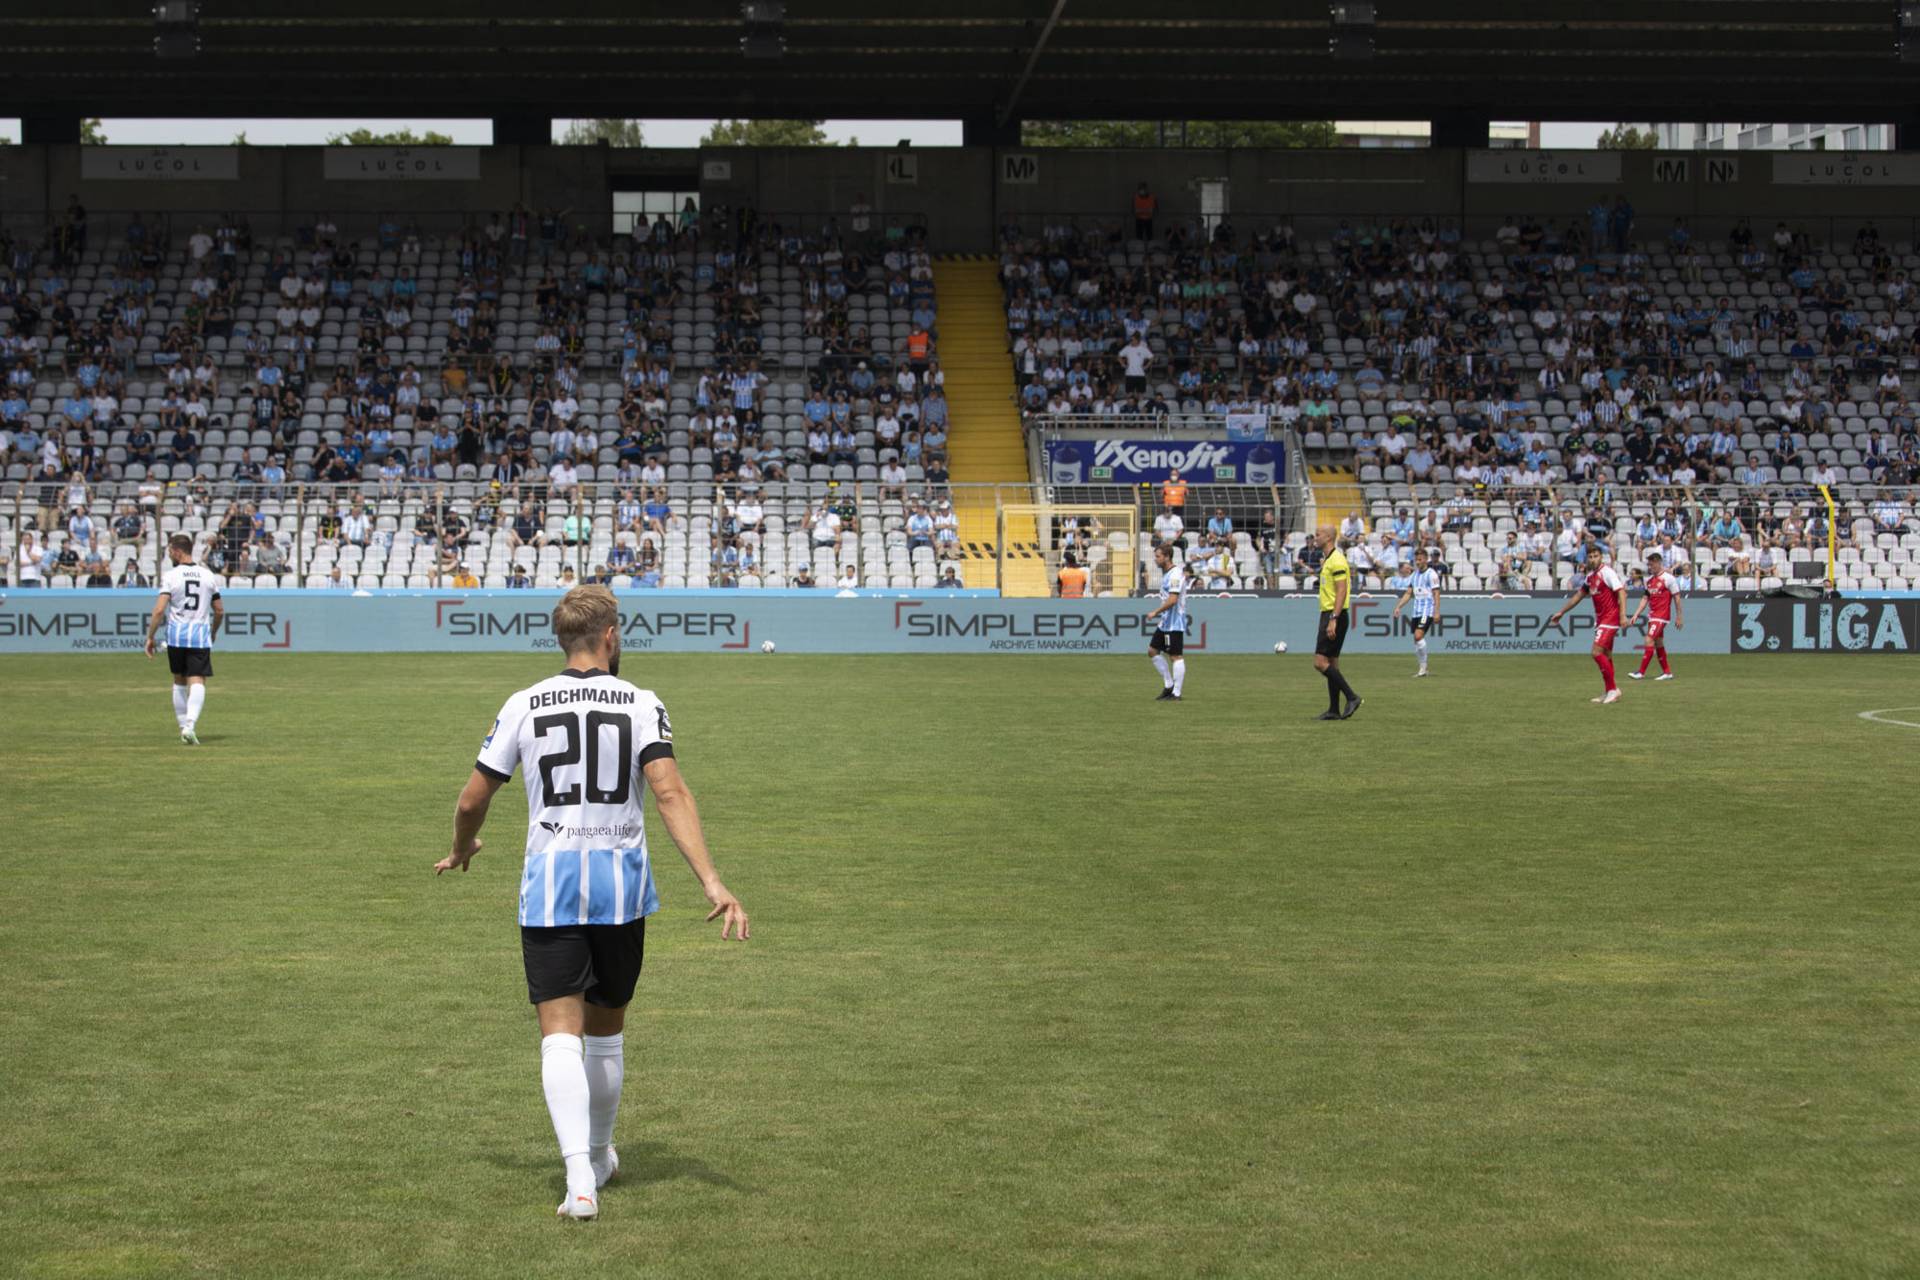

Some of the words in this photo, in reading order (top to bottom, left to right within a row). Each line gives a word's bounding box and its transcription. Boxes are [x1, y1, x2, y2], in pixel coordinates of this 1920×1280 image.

[118, 160, 200, 171] LUCOL
[361, 160, 443, 171] LUCOL
[898, 157, 913, 178] L
[1007, 158, 1027, 178] M
[1663, 160, 1685, 182] M
[1709, 160, 1727, 182] N
[1809, 165, 1889, 176] LUCOL
[184, 580, 200, 610] 5
[1736, 603, 1780, 650] 3.
[1792, 603, 1908, 650] LIGA
[72, 638, 118, 649] ARCHIVE
[989, 639, 1035, 649] ARCHIVE
[1037, 639, 1111, 649] MANAGEMENT
[1445, 640, 1490, 650] ARCHIVE
[1493, 640, 1566, 650] MANAGEMENT
[530, 688, 635, 710] DEICHMANN
[533, 710, 632, 807] 20
